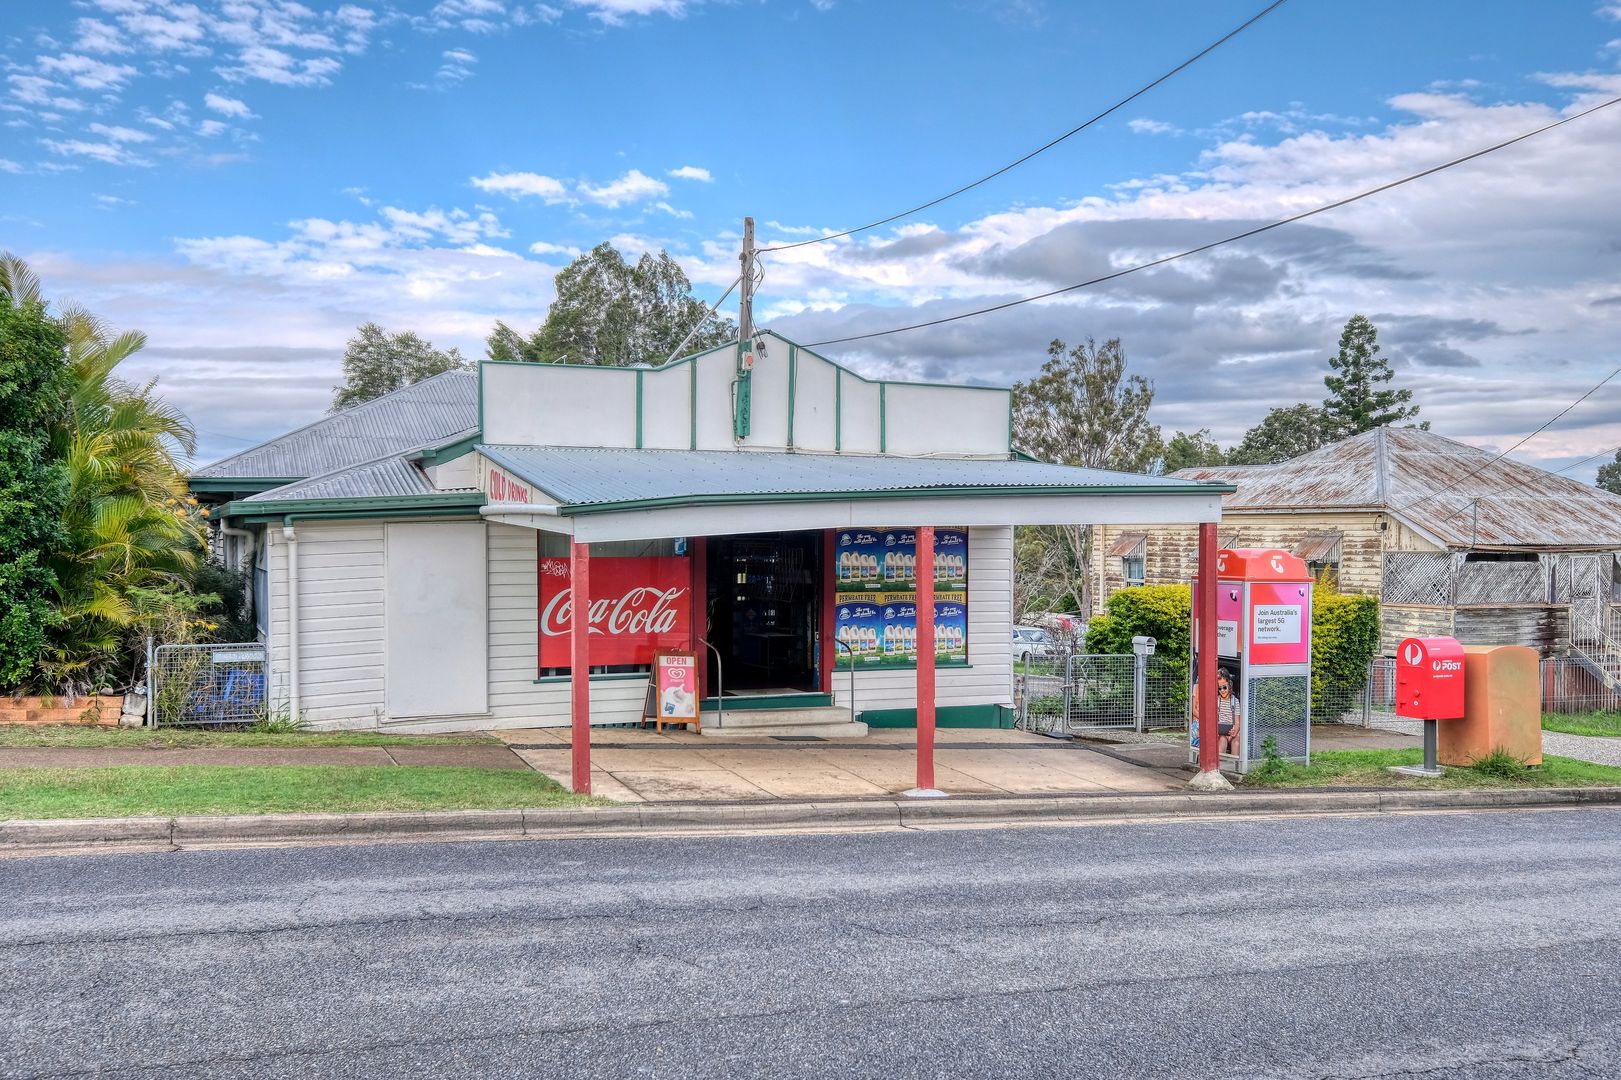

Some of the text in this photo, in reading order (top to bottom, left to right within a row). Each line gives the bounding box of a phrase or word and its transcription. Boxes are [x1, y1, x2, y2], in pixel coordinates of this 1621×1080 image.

[490, 469, 528, 504] COLD DRINKS
[839, 594, 876, 602] PERMEATE FREE
[541, 587, 686, 636] Coa-Cola
[1257, 617, 1277, 625] largest
[666, 657, 687, 665] OPEN
[1442, 662, 1461, 670] POST
